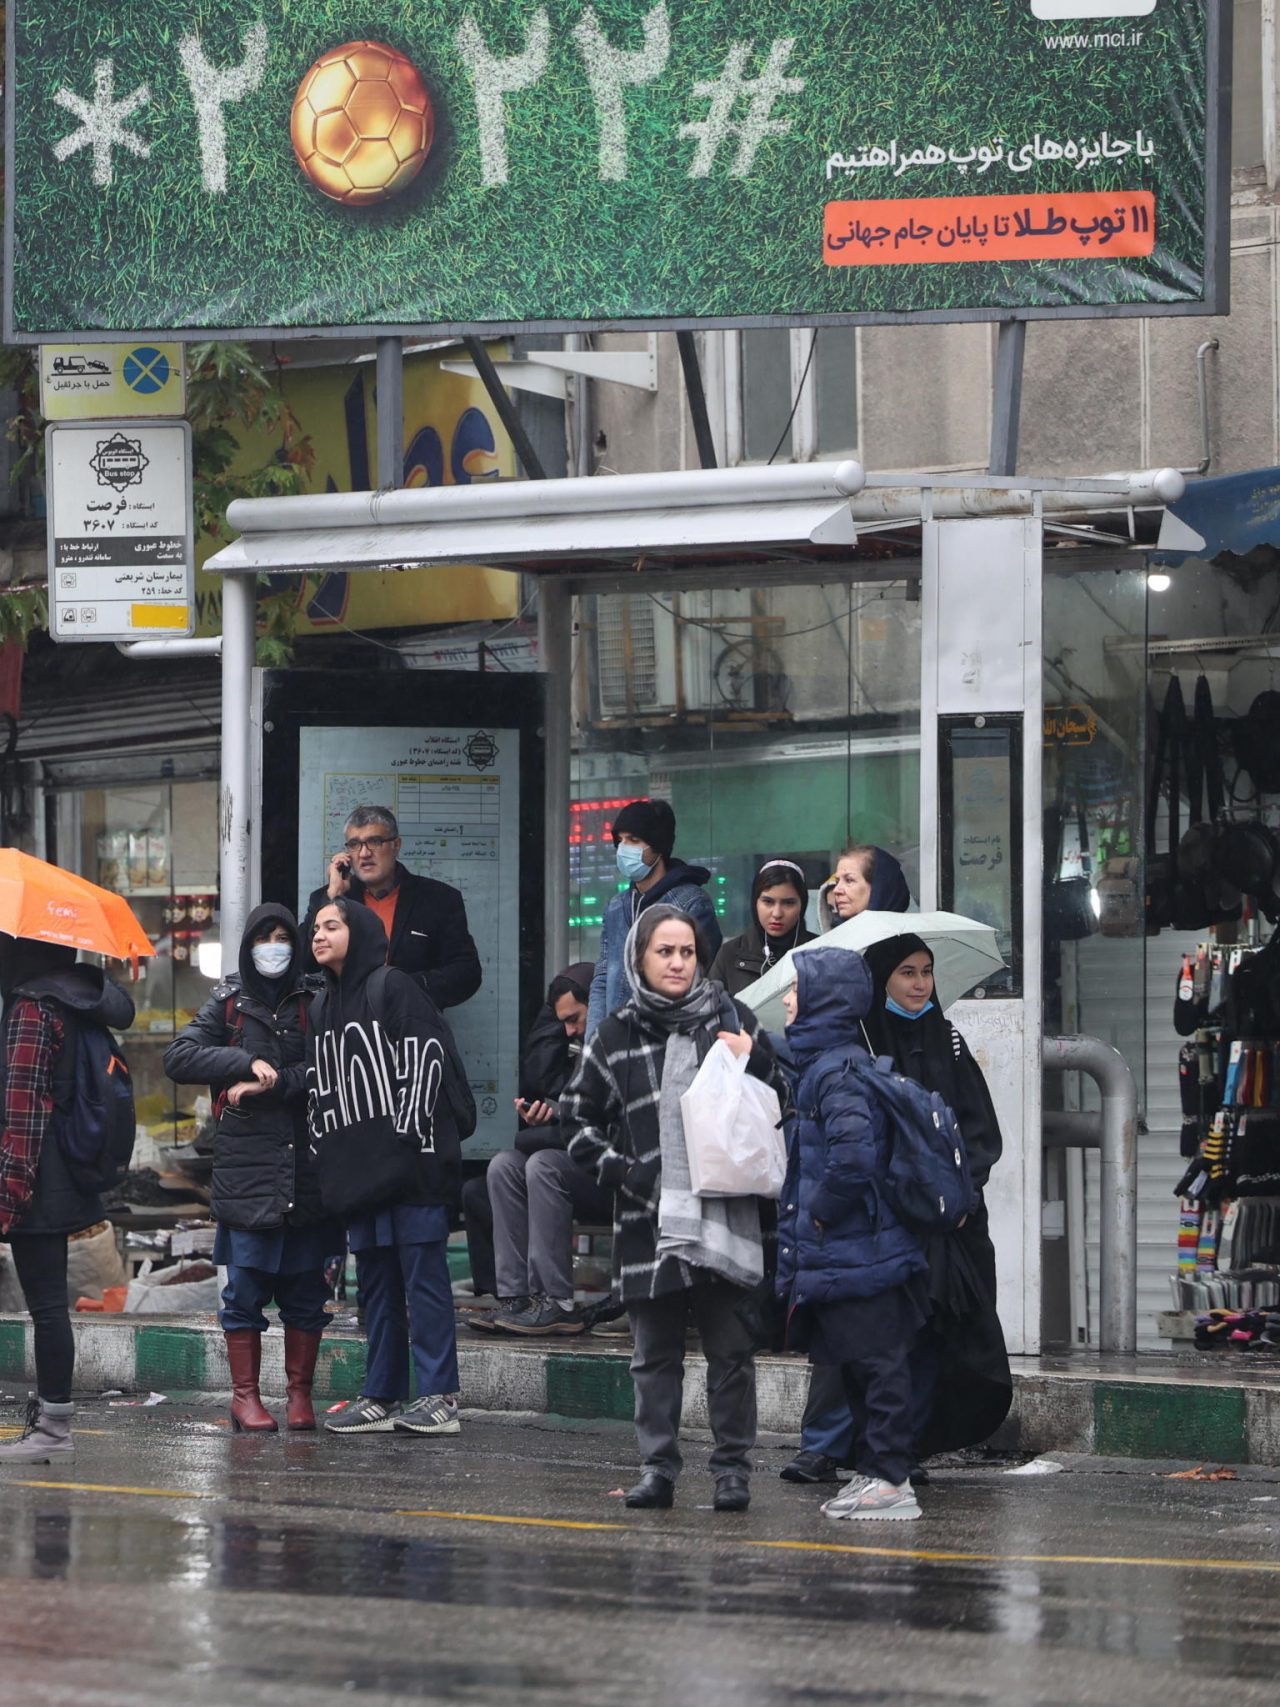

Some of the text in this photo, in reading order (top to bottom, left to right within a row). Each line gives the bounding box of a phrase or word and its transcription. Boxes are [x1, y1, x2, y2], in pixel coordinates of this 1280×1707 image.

[1045, 31, 1144, 49] www.mci.ir
[948, 137, 1004, 175] توپ
[1135, 130, 1154, 164] با
[826, 139, 947, 180] همراهتیم
[827, 205, 1149, 250] ۱۱ توپ طلا تا پایان جام جهانی
[84, 380, 90, 389] با
[93, 379, 110, 389] حمل
[86, 495, 127, 515] فرصت
[83, 519, 115, 532] ۳۶۰۷
[134, 540, 182, 552] خطوط عبوری
[115, 571, 183, 583] بیمارستان شریعتی
[959, 847, 1003, 871] فرصت
